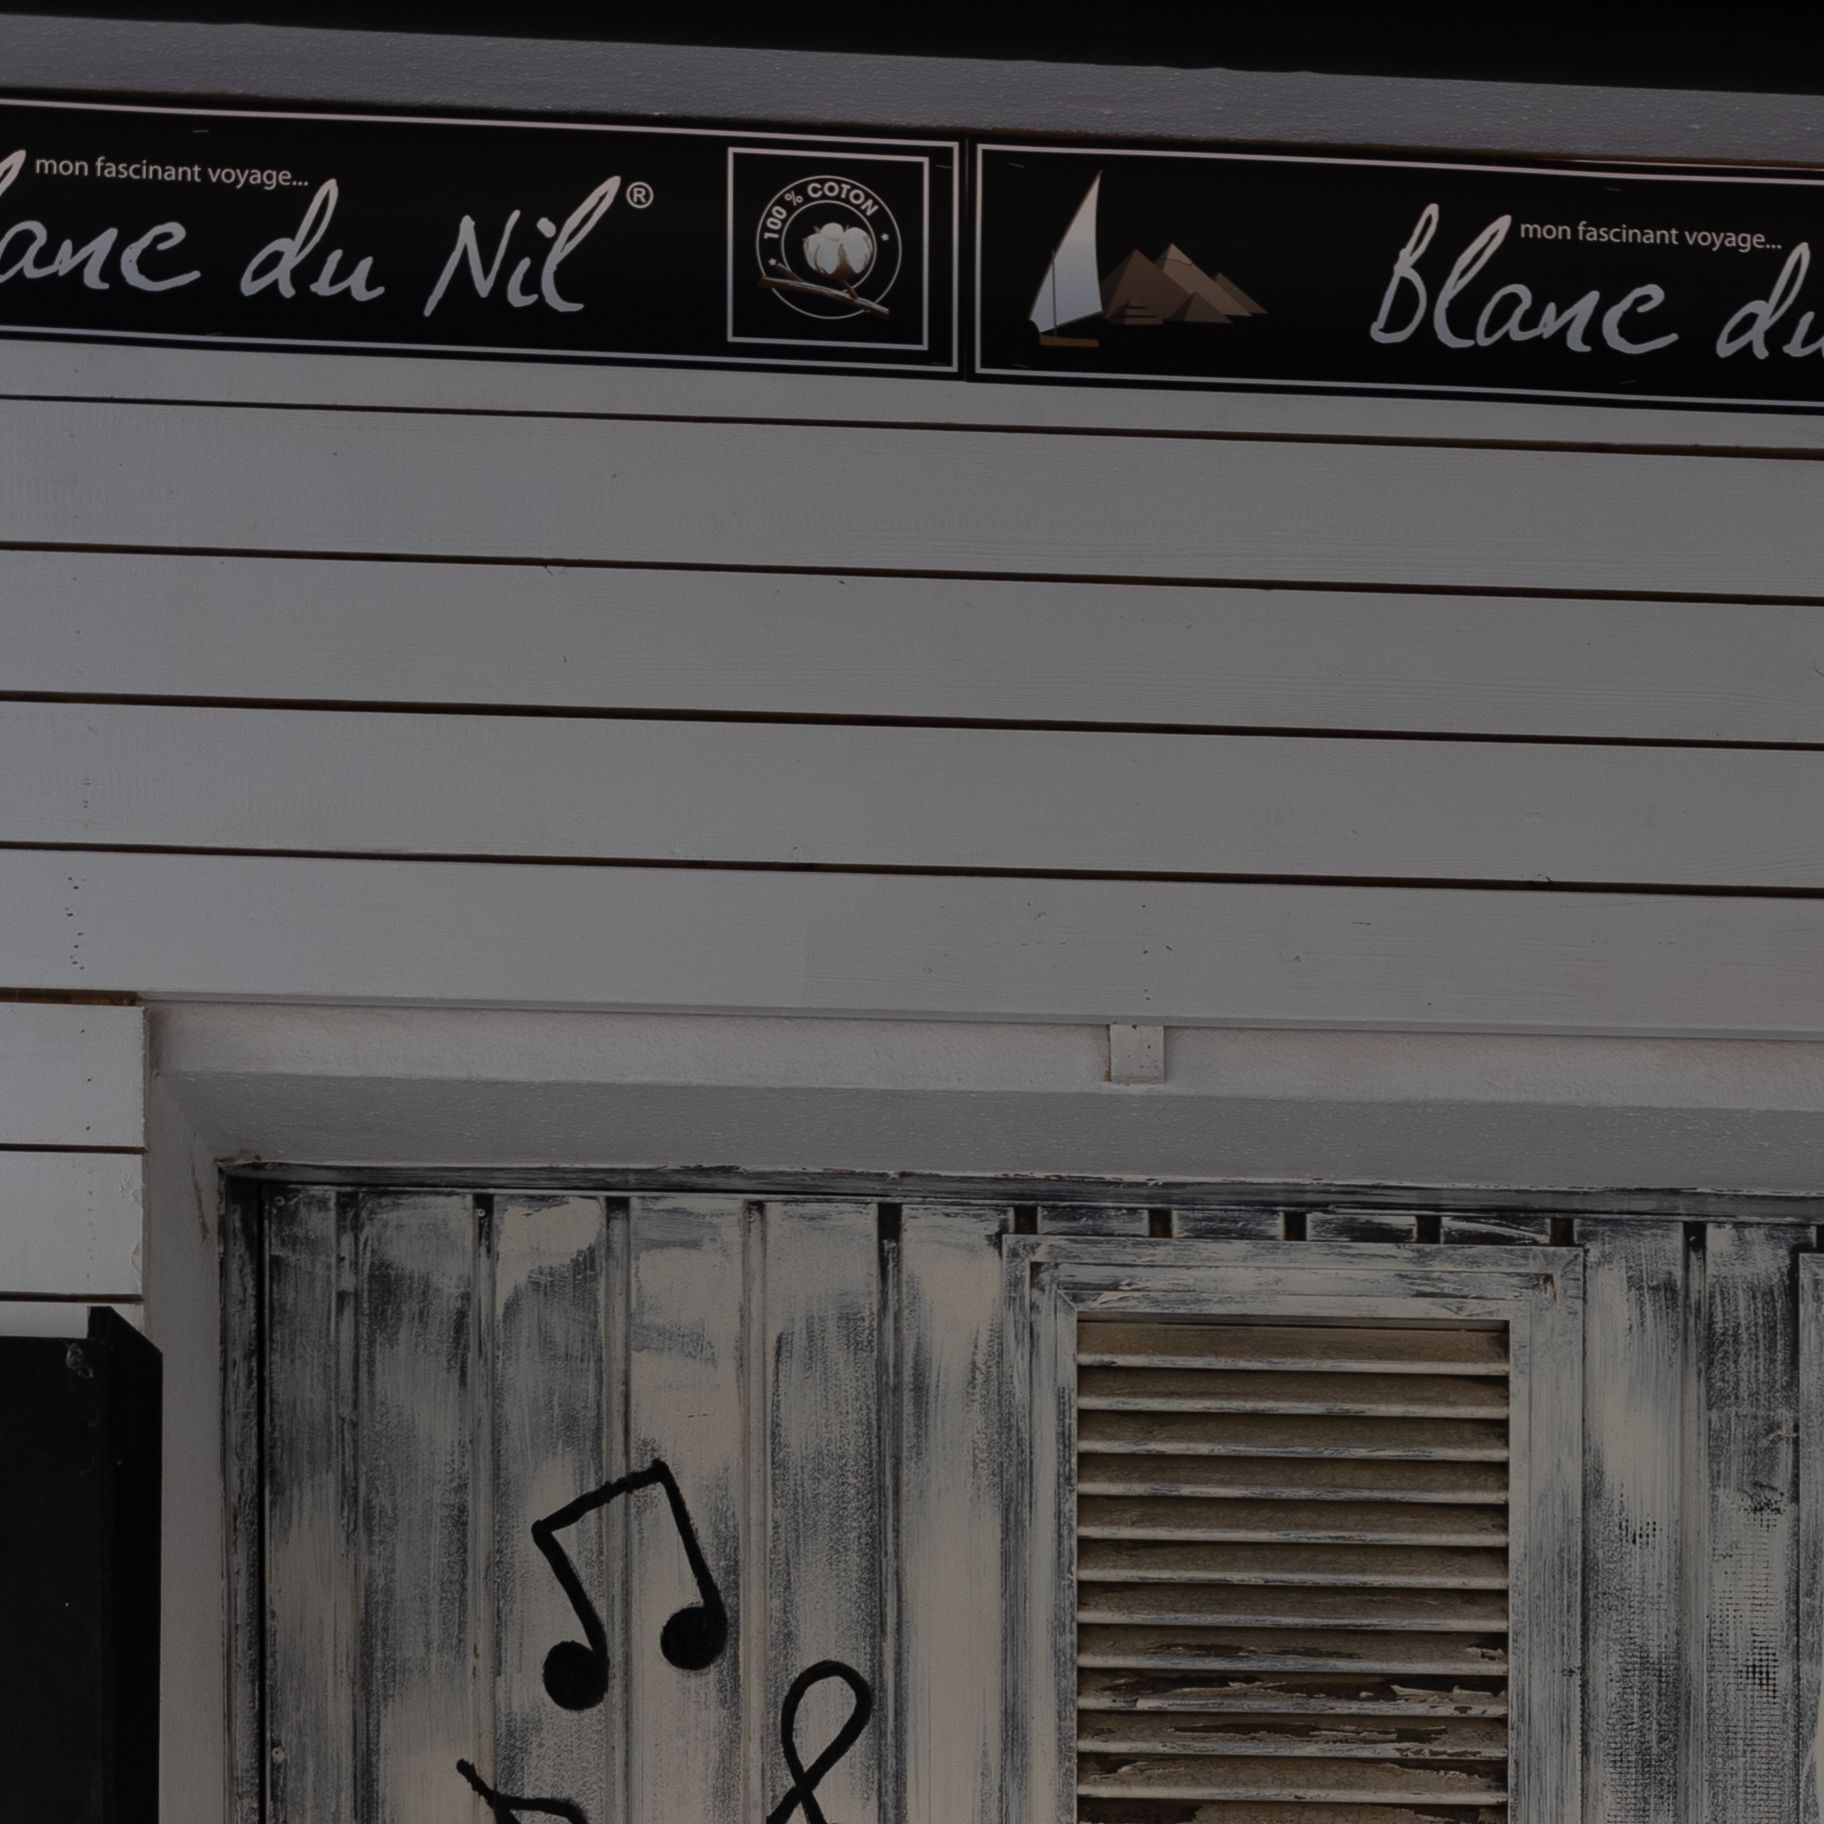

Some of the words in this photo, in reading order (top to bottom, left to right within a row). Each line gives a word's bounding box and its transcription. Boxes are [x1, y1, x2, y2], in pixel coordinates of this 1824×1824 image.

[36, 158, 89, 177] mon
[95, 155, 202, 183] fascinant
[207, 167, 309, 191] voyage...
[763, 205, 788, 239] 100
[806, 181, 879, 217] COTON
[1520, 223, 1572, 240] mon
[1577, 220, 1679, 245] fascinant
[1684, 231, 1782, 253] voyage...
[240, 177, 386, 302] du
[1369, 202, 1679, 355] Blanc
